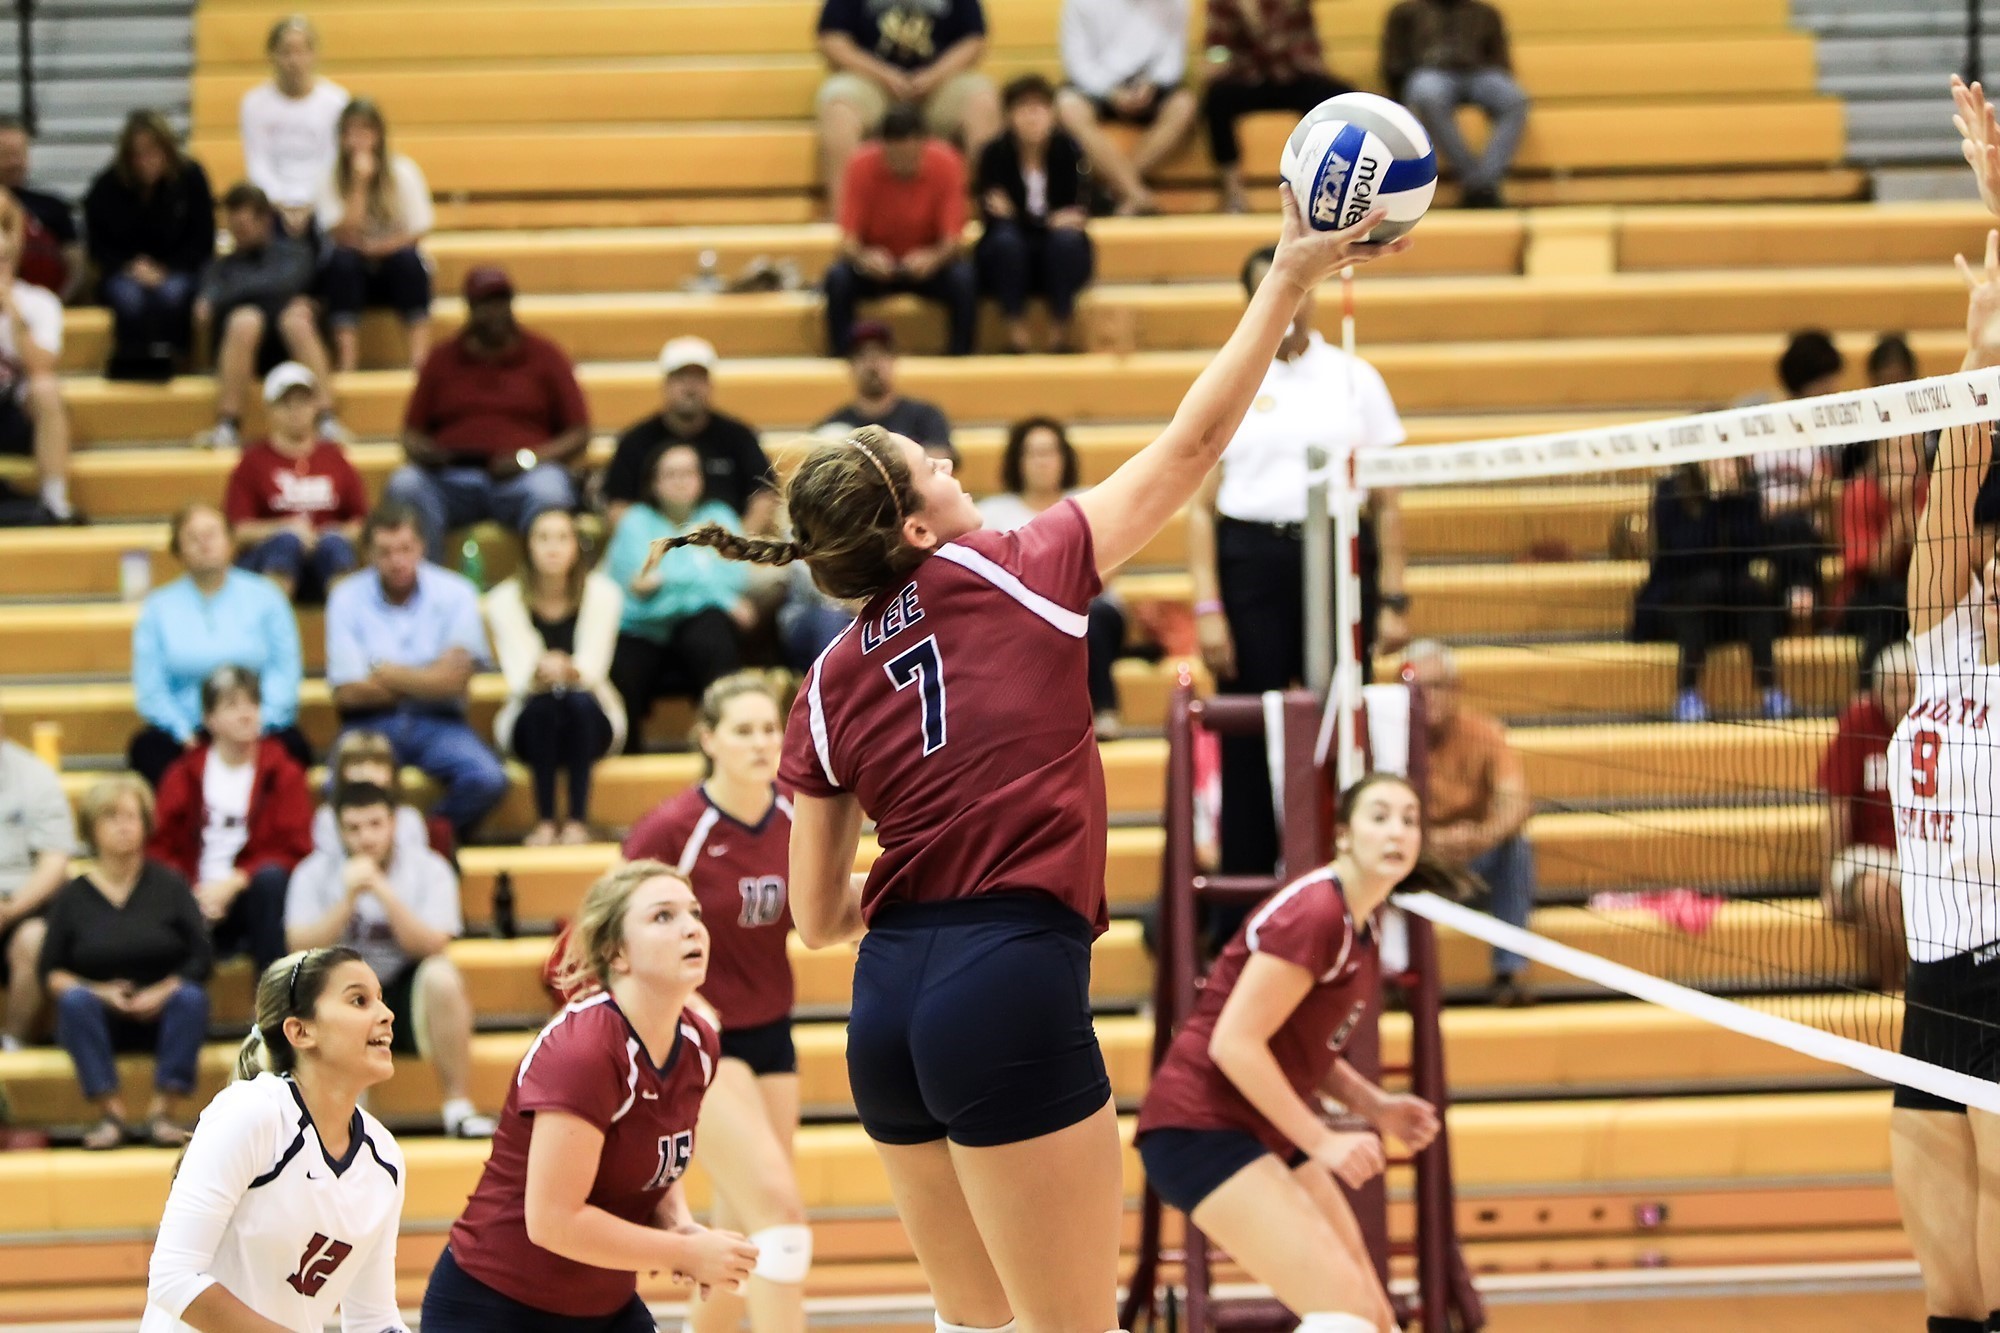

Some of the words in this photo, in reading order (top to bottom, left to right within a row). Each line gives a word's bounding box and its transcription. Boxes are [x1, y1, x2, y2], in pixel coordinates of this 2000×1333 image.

[1343, 156, 1378, 227] molte
[1905, 383, 1951, 416] VOLLEYBALL
[861, 580, 926, 655] LEE
[882, 633, 947, 758] 7
[1911, 730, 1941, 798] 9
[1900, 806, 1955, 843] STATE
[737, 874, 787, 929] 10
[286, 1232, 353, 1298] 12
